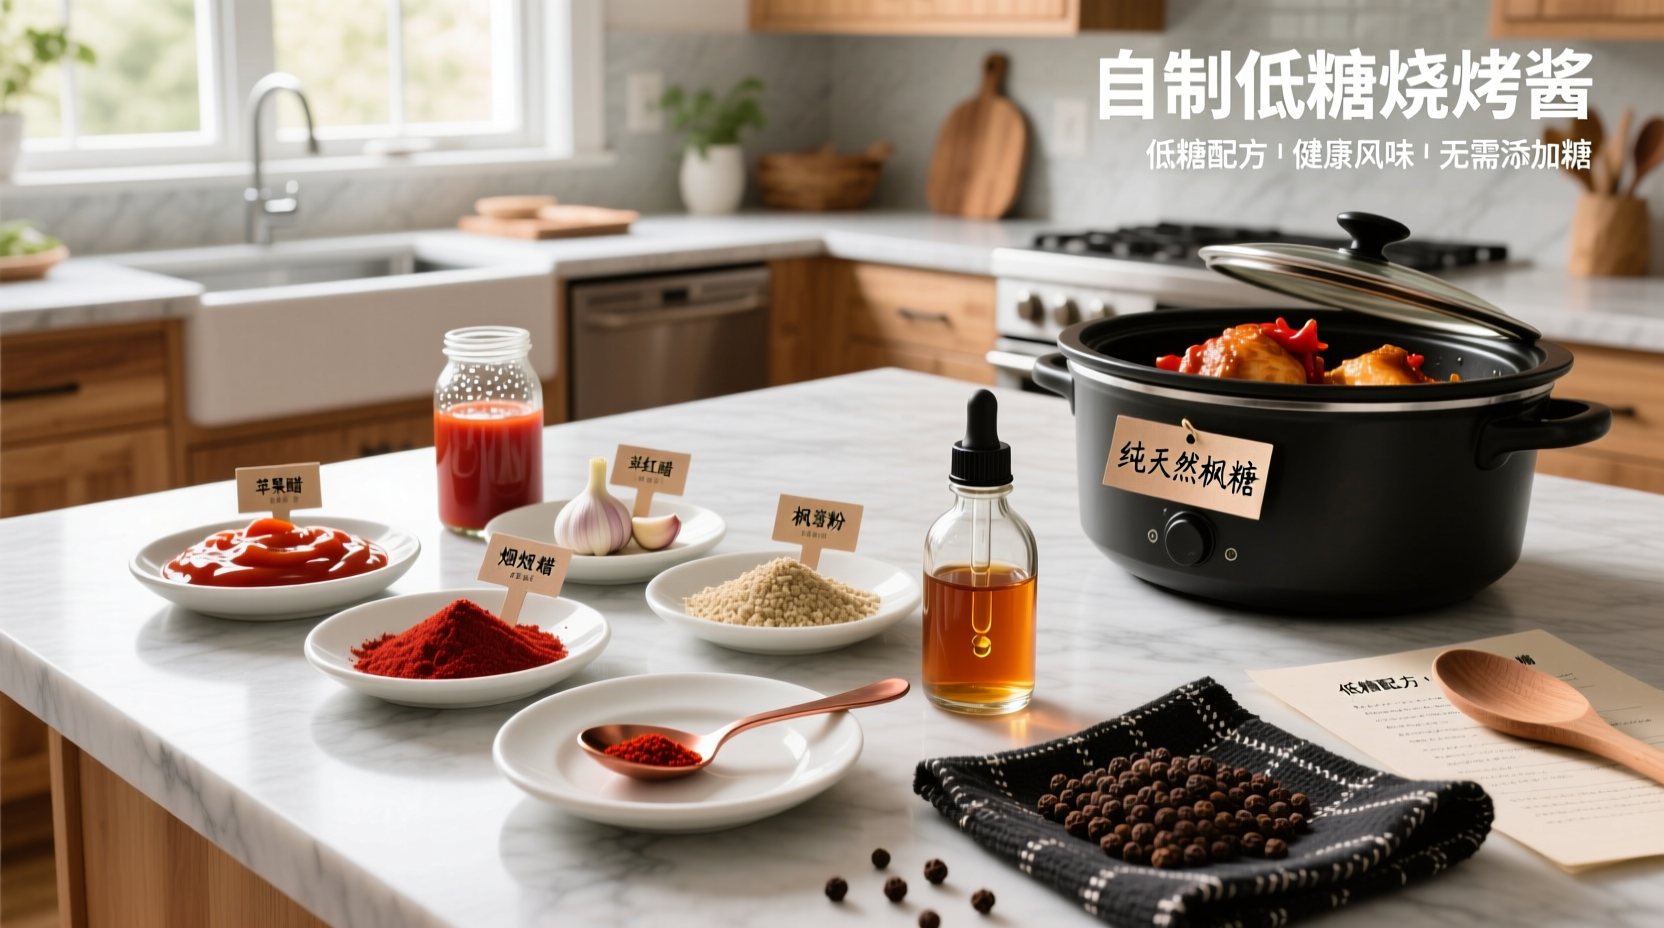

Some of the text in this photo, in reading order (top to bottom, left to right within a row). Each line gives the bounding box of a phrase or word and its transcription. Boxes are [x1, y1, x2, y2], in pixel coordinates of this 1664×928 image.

[1117, 440, 1260, 497] 纯天然枫糖
